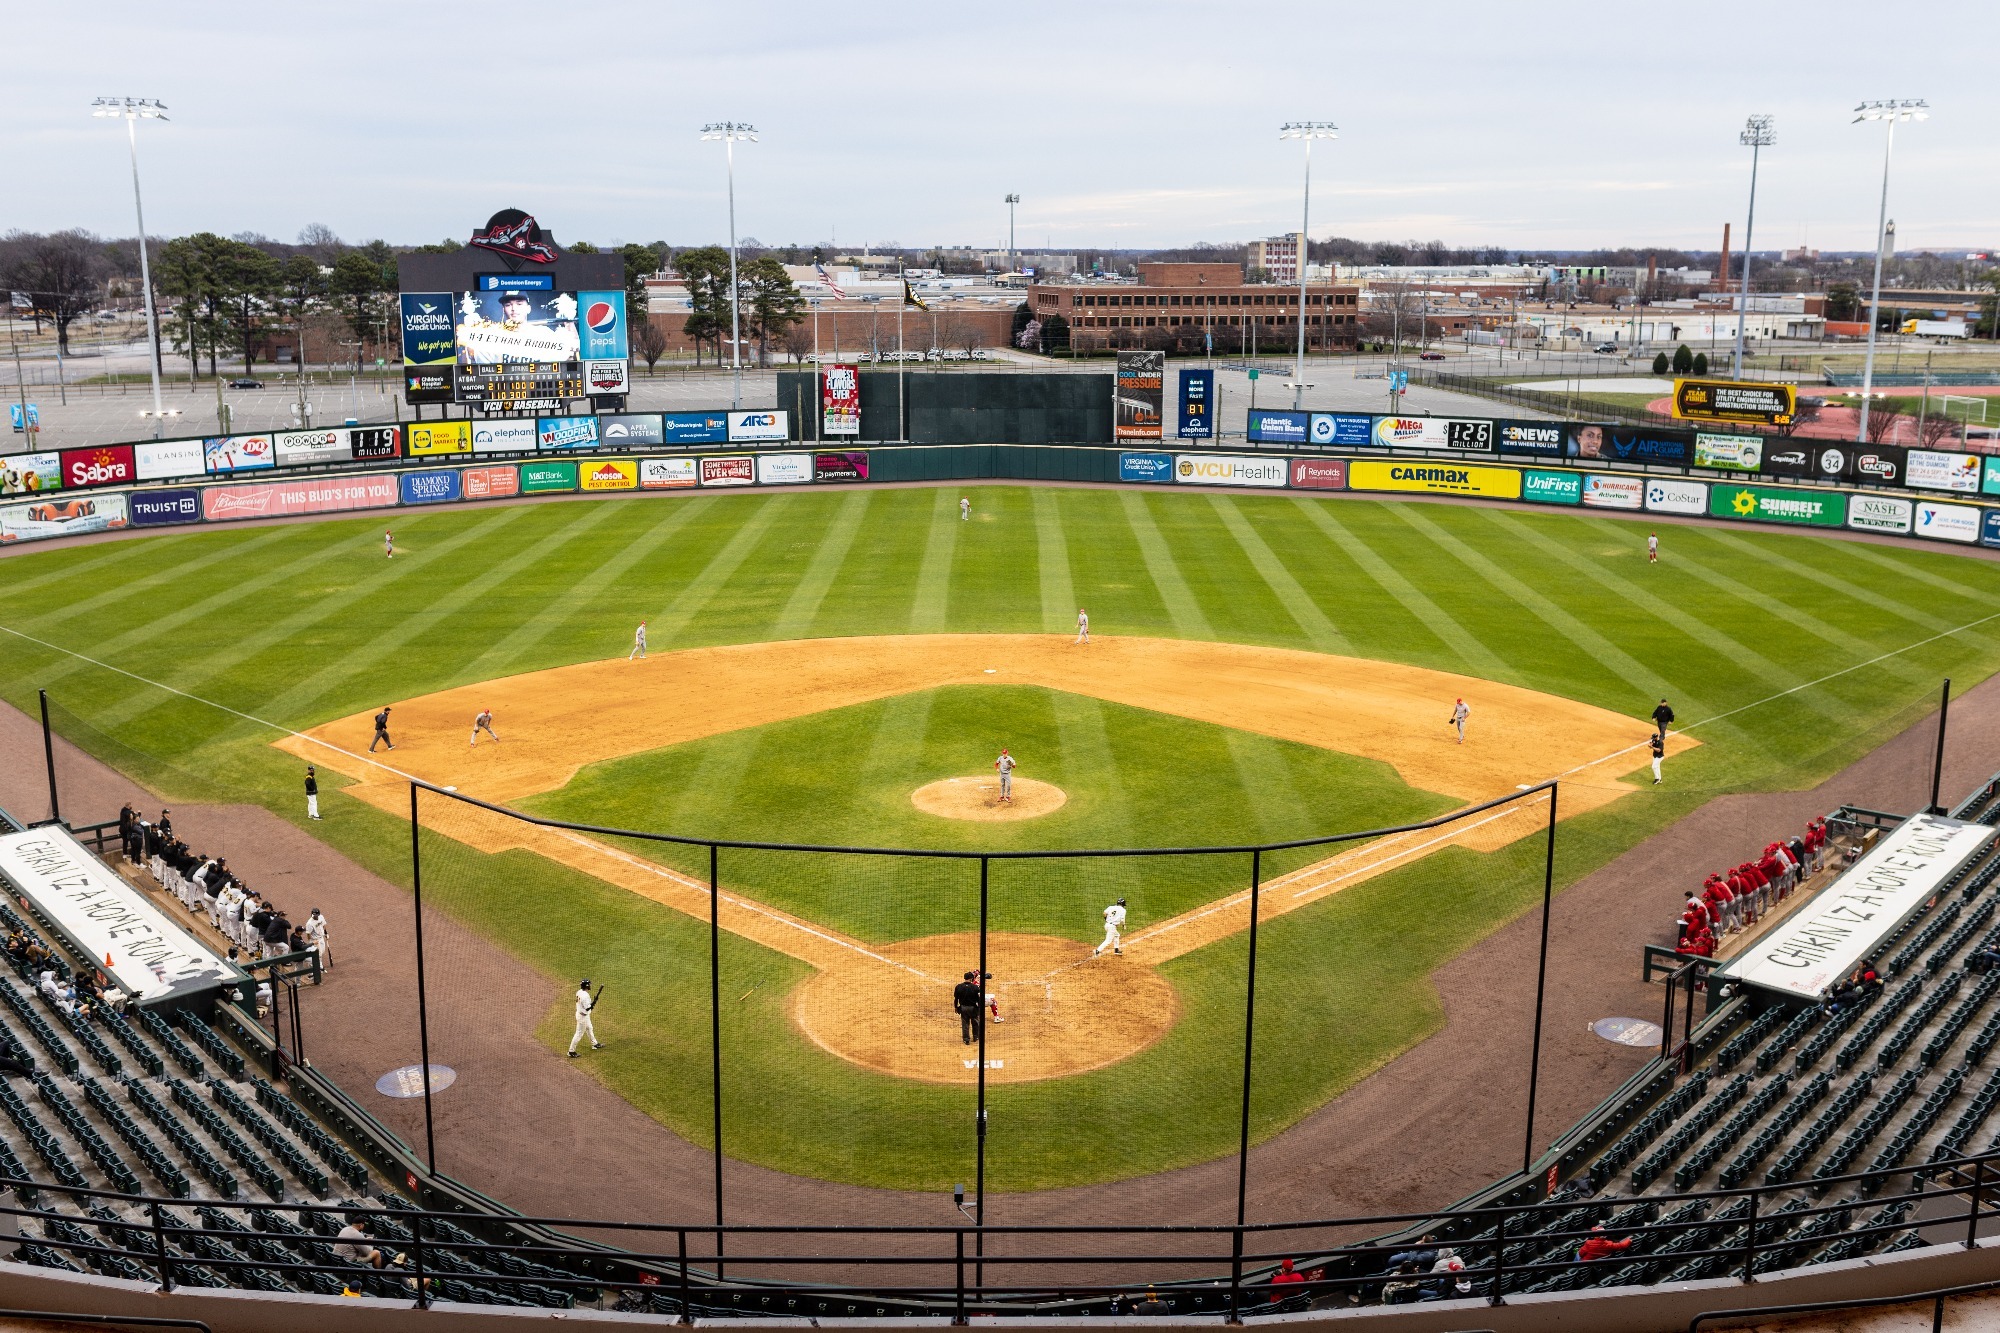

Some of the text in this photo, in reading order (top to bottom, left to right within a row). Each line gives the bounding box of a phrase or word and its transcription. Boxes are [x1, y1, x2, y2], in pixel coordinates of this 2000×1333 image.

[406, 315, 449, 323] VIRGINIA
[418, 340, 453, 354] We got you!
[590, 337, 616, 347] pepsi
[466, 366, 472, 374] 4
[497, 365, 502, 374] 3
[530, 364, 535, 372] 2
[553, 363, 558, 372] 0
[592, 373, 623, 381] SQUIRRELS
[828, 370, 854, 380] LOUDEST
[826, 379, 855, 390] FLAVORS
[1120, 378, 1161, 388] PRESSURE
[833, 390, 850, 400] EVER
[484, 400, 560, 411] VCU BASEBALL
[1716, 402, 1757, 410] CONSTRUCTION
[740, 415, 775, 426] ARC3
[1396, 419, 1422, 430] MEGA
[495, 429, 534, 438] elephant
[542, 426, 588, 443] WOODFIN
[1443, 424, 1448, 435] $
[1454, 424, 1488, 441] 126
[1518, 428, 1559, 442] NEWS
[359, 430, 392, 447] 119
[247, 441, 265, 452] DQ
[1638, 440, 1658, 452] AIR
[157, 450, 200, 460] LANSING
[358, 448, 390, 456] MILLION
[1825, 459, 1839, 469] 34
[72, 462, 126, 485] Sabra
[529, 472, 545, 480] M&T
[592, 471, 622, 480] DODSON
[1195, 462, 1281, 480] VCU Health
[1308, 468, 1340, 477] Reynolds
[412, 476, 450, 486] DIAMOND
[1527, 476, 1578, 492] UniFirst
[1602, 482, 1638, 491] HURRICANE
[280, 484, 392, 505] THIS BUD'S FOR YOU.
[412, 484, 450, 494] SPRINGS
[217, 496, 266, 508] Budweiser
[1668, 492, 1700, 503] CoStar
[135, 502, 178, 513] TRUIST
[1760, 498, 1821, 514] SUNBELT
[1864, 503, 1896, 514] NASH
[1768, 510, 1812, 518] RENTALS
[1897, 836, 1952, 863] RUN
[1854, 856, 1928, 894] HOME
[66, 890, 106, 902] A
[1840, 894, 1886, 907] A
[80, 898, 152, 938] HOME
[122, 936, 186, 966] RUN
